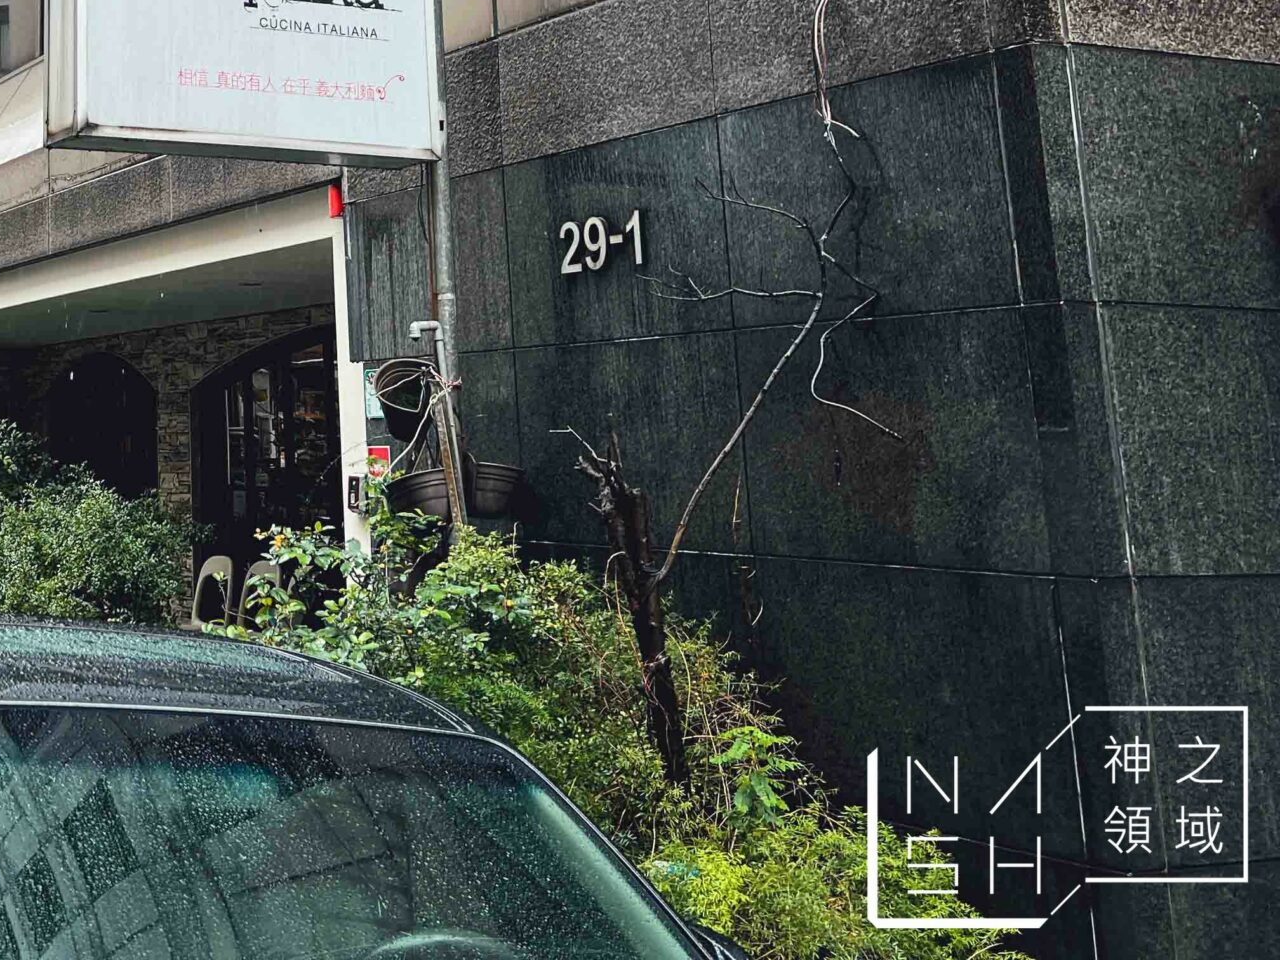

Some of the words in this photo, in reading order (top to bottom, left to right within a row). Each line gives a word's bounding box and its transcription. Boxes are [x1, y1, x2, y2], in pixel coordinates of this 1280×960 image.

[258, 16, 312, 33] CUCINA
[317, 23, 378, 39] ITALIANA
[177, 67, 209, 88] 相信
[216, 70, 278, 93] 真的有人
[559, 209, 643, 274] 29-1
